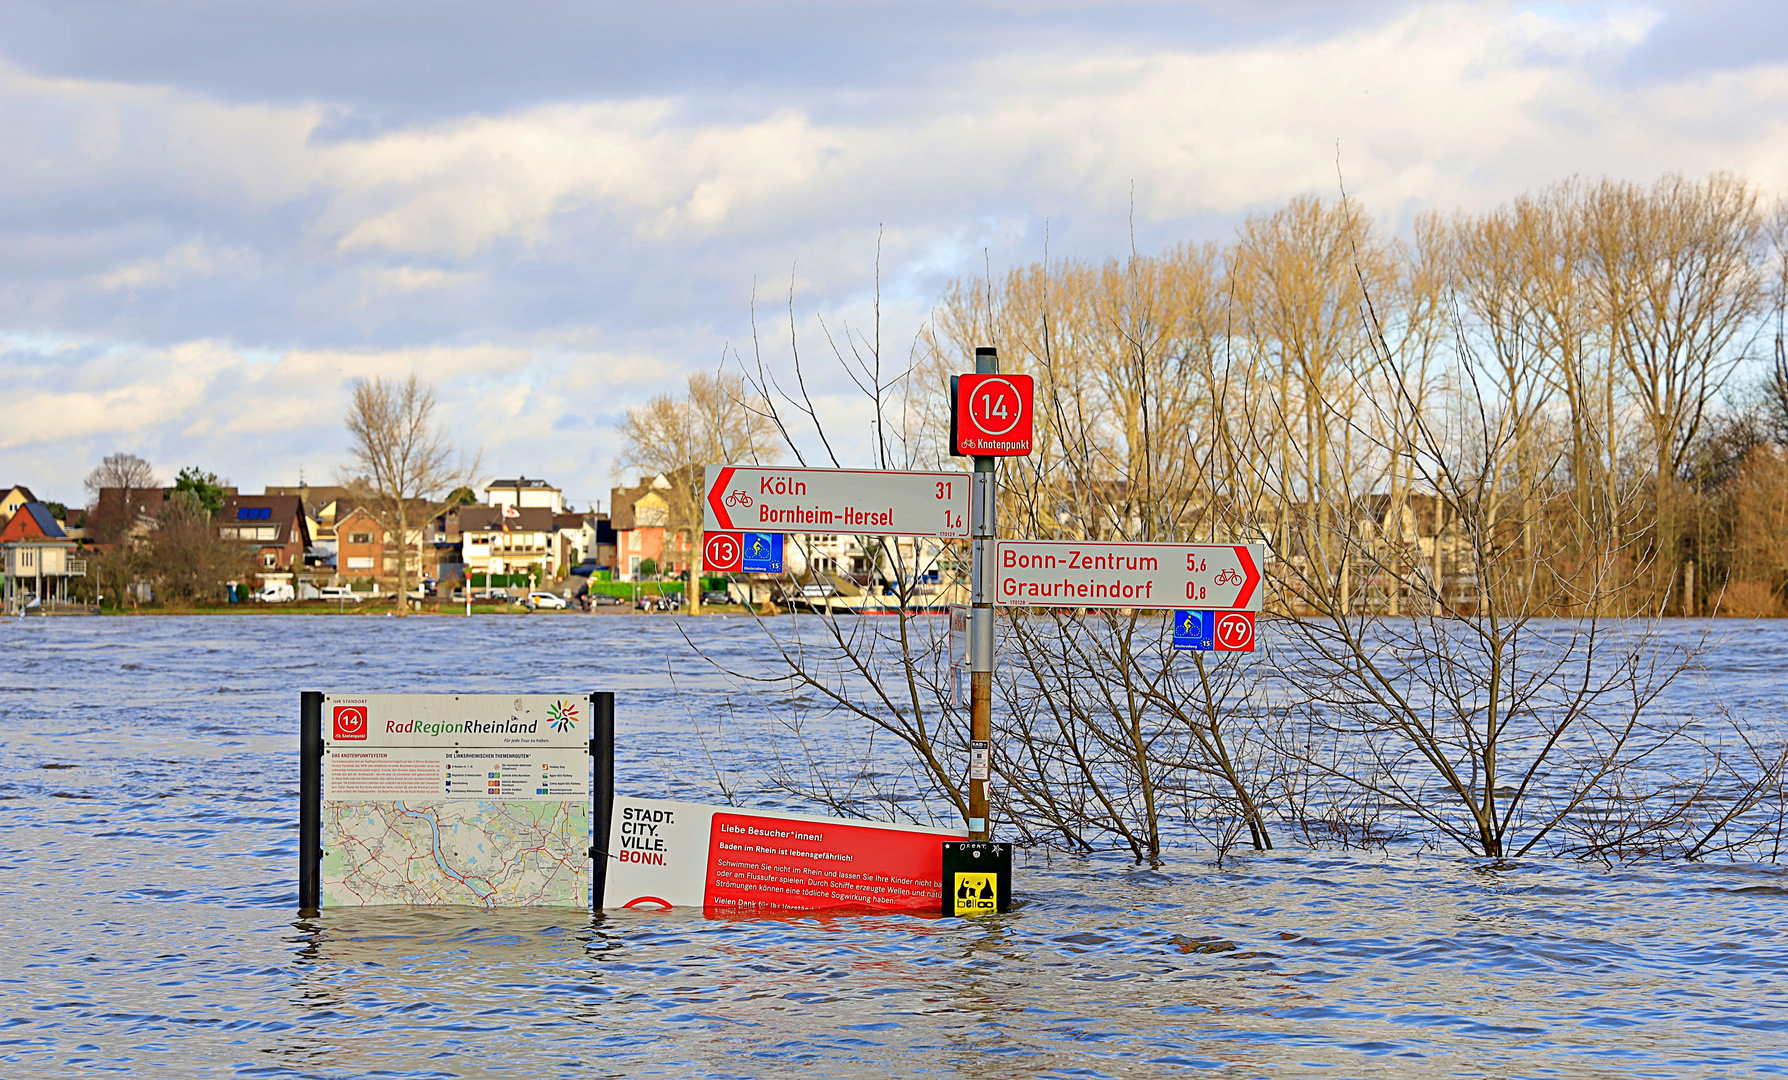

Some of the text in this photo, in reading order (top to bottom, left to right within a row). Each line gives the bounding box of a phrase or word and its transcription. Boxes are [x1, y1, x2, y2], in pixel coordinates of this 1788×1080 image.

[982, 393, 1008, 420] 14
[977, 438, 1029, 452] Knotenpunkt
[760, 476, 952, 500] Köln 31
[759, 504, 962, 530] Bornheim-Hersel 1,6
[712, 542, 733, 561] 13
[1003, 549, 1207, 573] Bonn-Zentrum 5,6
[1003, 577, 1207, 601] Graurheindorf 0,8
[1222, 621, 1247, 641] 79
[342, 715, 358, 726] 14
[385, 719, 538, 737] RadRegionRheinland
[622, 807, 675, 825] STADT.
[621, 821, 659, 837] CITY.
[721, 824, 746, 834] Liebe
[620, 835, 668, 852] VILLE.
[719, 842, 854, 862] Baden im Rhein ist lebensgefährlich!
[619, 849, 667, 867] BONN.
[717, 858, 943, 888] Schwimmen Sie nicht im Rhein und lassen Sie Ihre Kinder nicht ba
[715, 880, 896, 905] Strömungen können eine tödliche Sogwirkung haben.
[716, 869, 733, 878] oder
[746, 871, 778, 882] Flussufer
[779, 875, 806, 885] spielen.
[807, 878, 829, 887] Durch
[830, 880, 854, 890] Schiffe
[855, 884, 886, 894] erzeugte
[887, 886, 911, 895] Wellen
[912, 888, 926, 897] und
[926, 889, 943, 899] natü
[714, 896, 737, 906] Vielen
[738, 898, 756, 908] Dank
[957, 898, 994, 909] belloo
